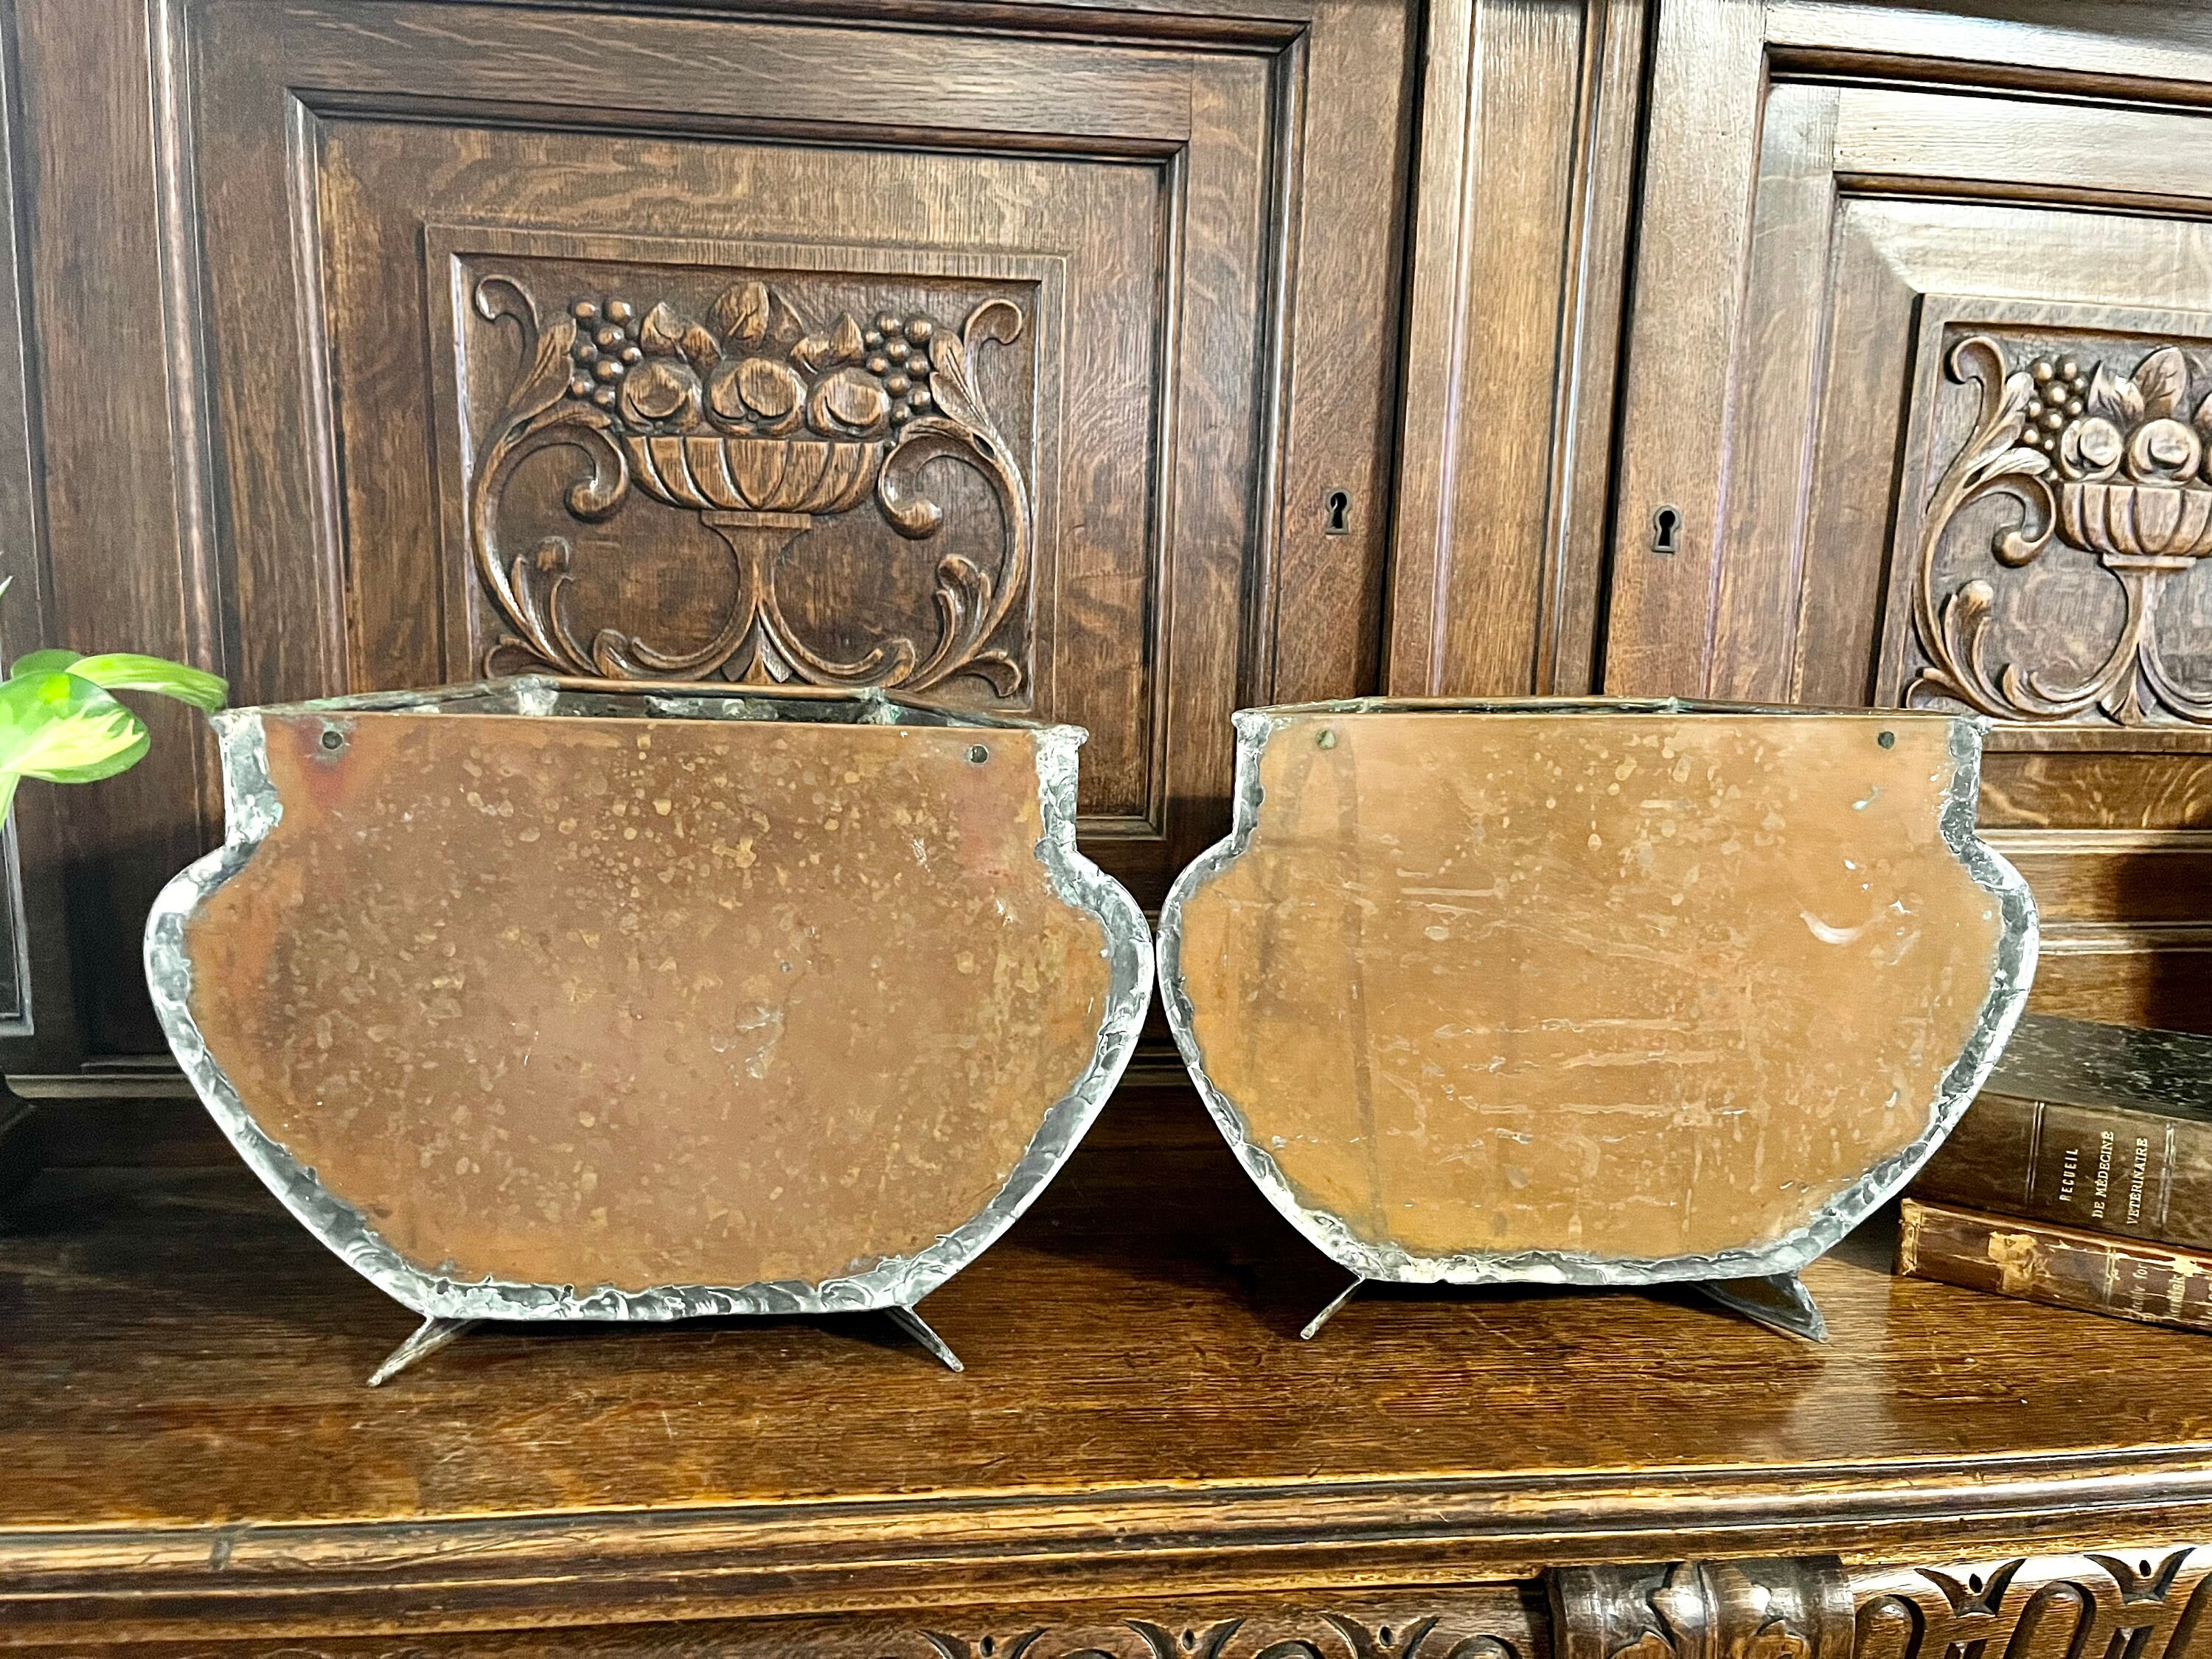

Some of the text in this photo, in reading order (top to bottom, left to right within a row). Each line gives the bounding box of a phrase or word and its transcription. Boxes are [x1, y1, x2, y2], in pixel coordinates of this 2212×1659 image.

[2059, 1149, 2079, 1202] RECUEIL
[2091, 1201, 2105, 1218] DE
[2132, 1265, 2149, 1280] for
